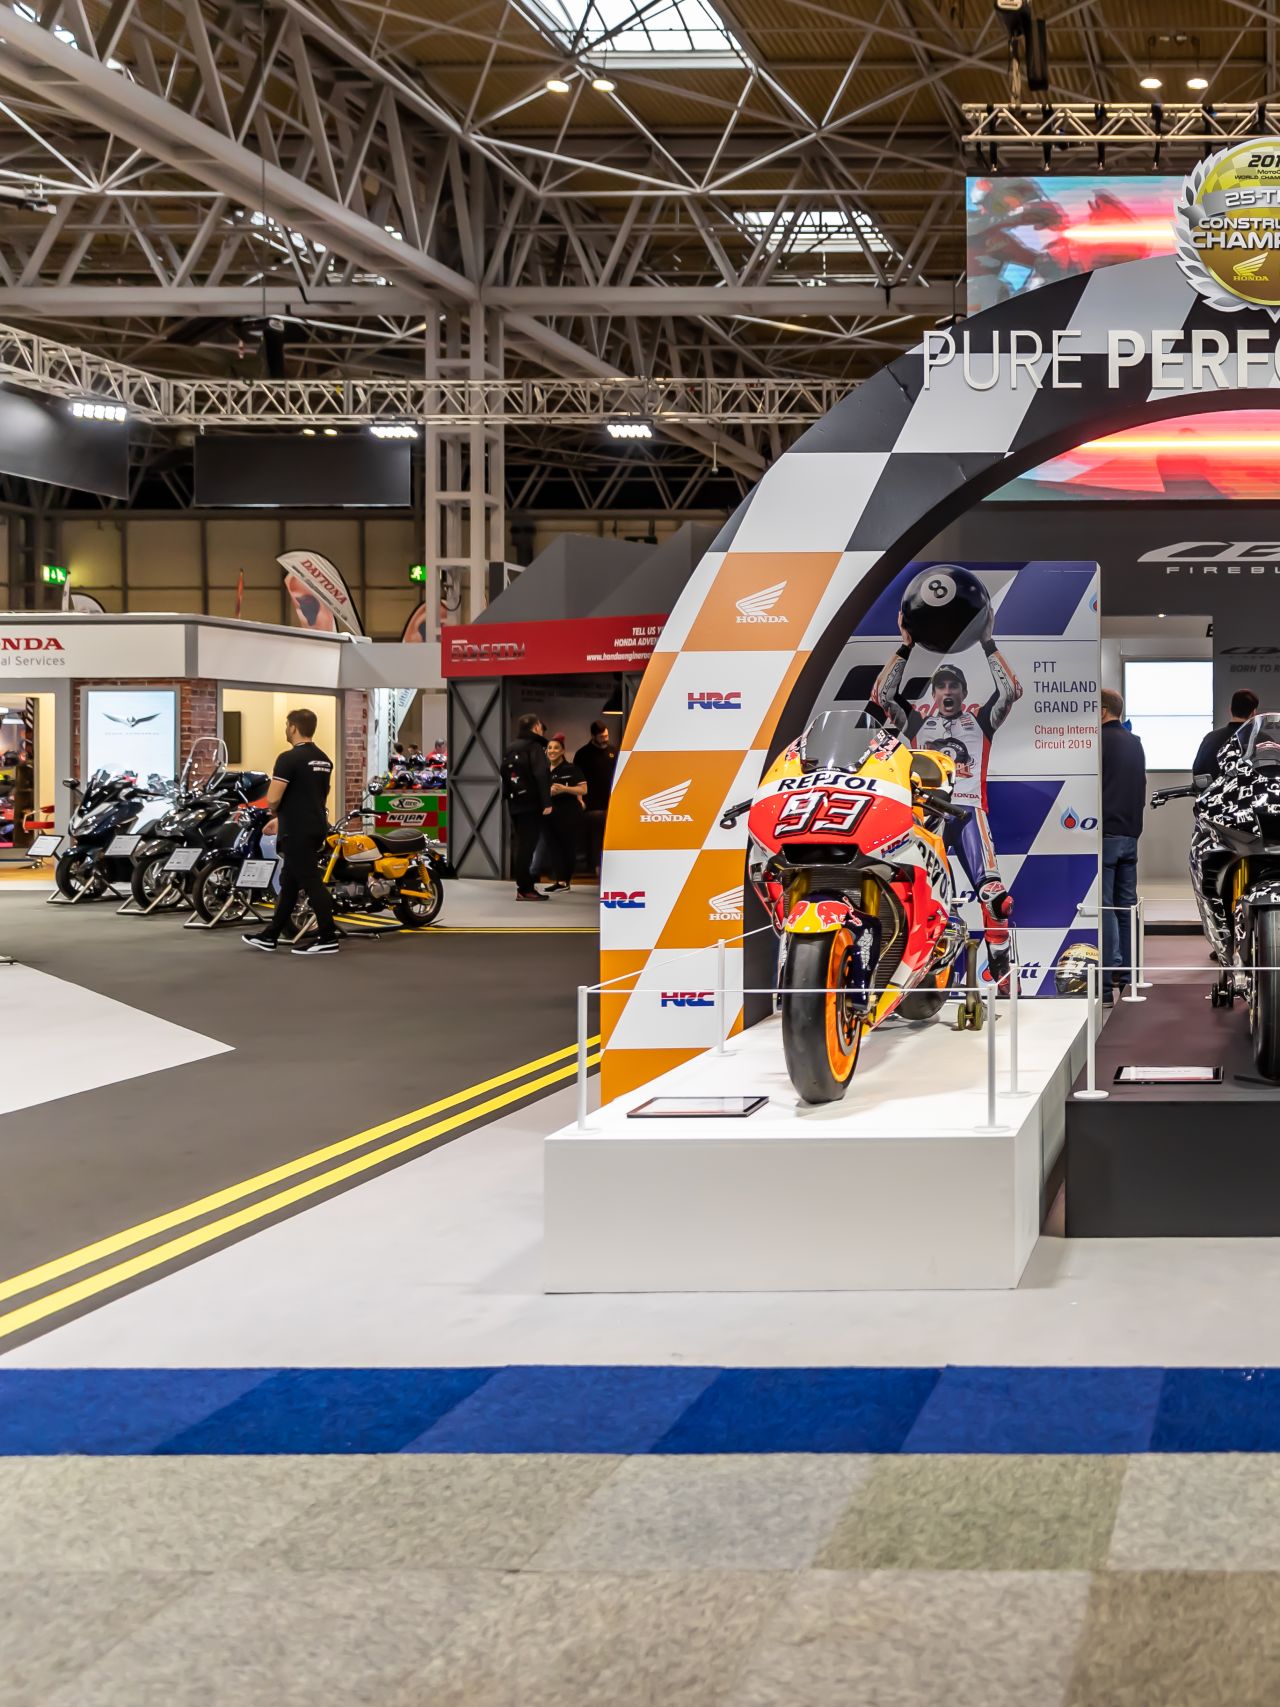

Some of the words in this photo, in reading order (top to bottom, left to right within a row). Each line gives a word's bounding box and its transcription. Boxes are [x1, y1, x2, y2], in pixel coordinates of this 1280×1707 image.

[923, 330, 1083, 390] PURE
[301, 558, 348, 605] DAYTONA
[928, 579, 948, 599] 8
[736, 615, 789, 623] HONDA
[632, 627, 646, 636] TELL
[647, 626, 656, 635] US
[0, 638, 65, 650] NDA
[614, 638, 637, 647] HONDA
[16, 655, 66, 666] Services
[1033, 661, 1056, 673] PTT
[1229, 664, 1256, 673] BORN
[1259, 664, 1271, 673] TO
[1033, 681, 1097, 693] THAILAND
[688, 692, 741, 710] HRC
[1034, 701, 1078, 713] GRAND
[1034, 725, 1065, 736] Chang
[1034, 739, 1065, 749] Circuit
[1068, 739, 1092, 749] 2019
[777, 772, 879, 792] REPSOL
[388, 814, 425, 824] NOLAN
[640, 814, 694, 822] HONDA
[773, 789, 876, 840] 93
[880, 833, 911, 858] HRC
[709, 913, 743, 921] HON
[661, 991, 714, 1007] HRC
